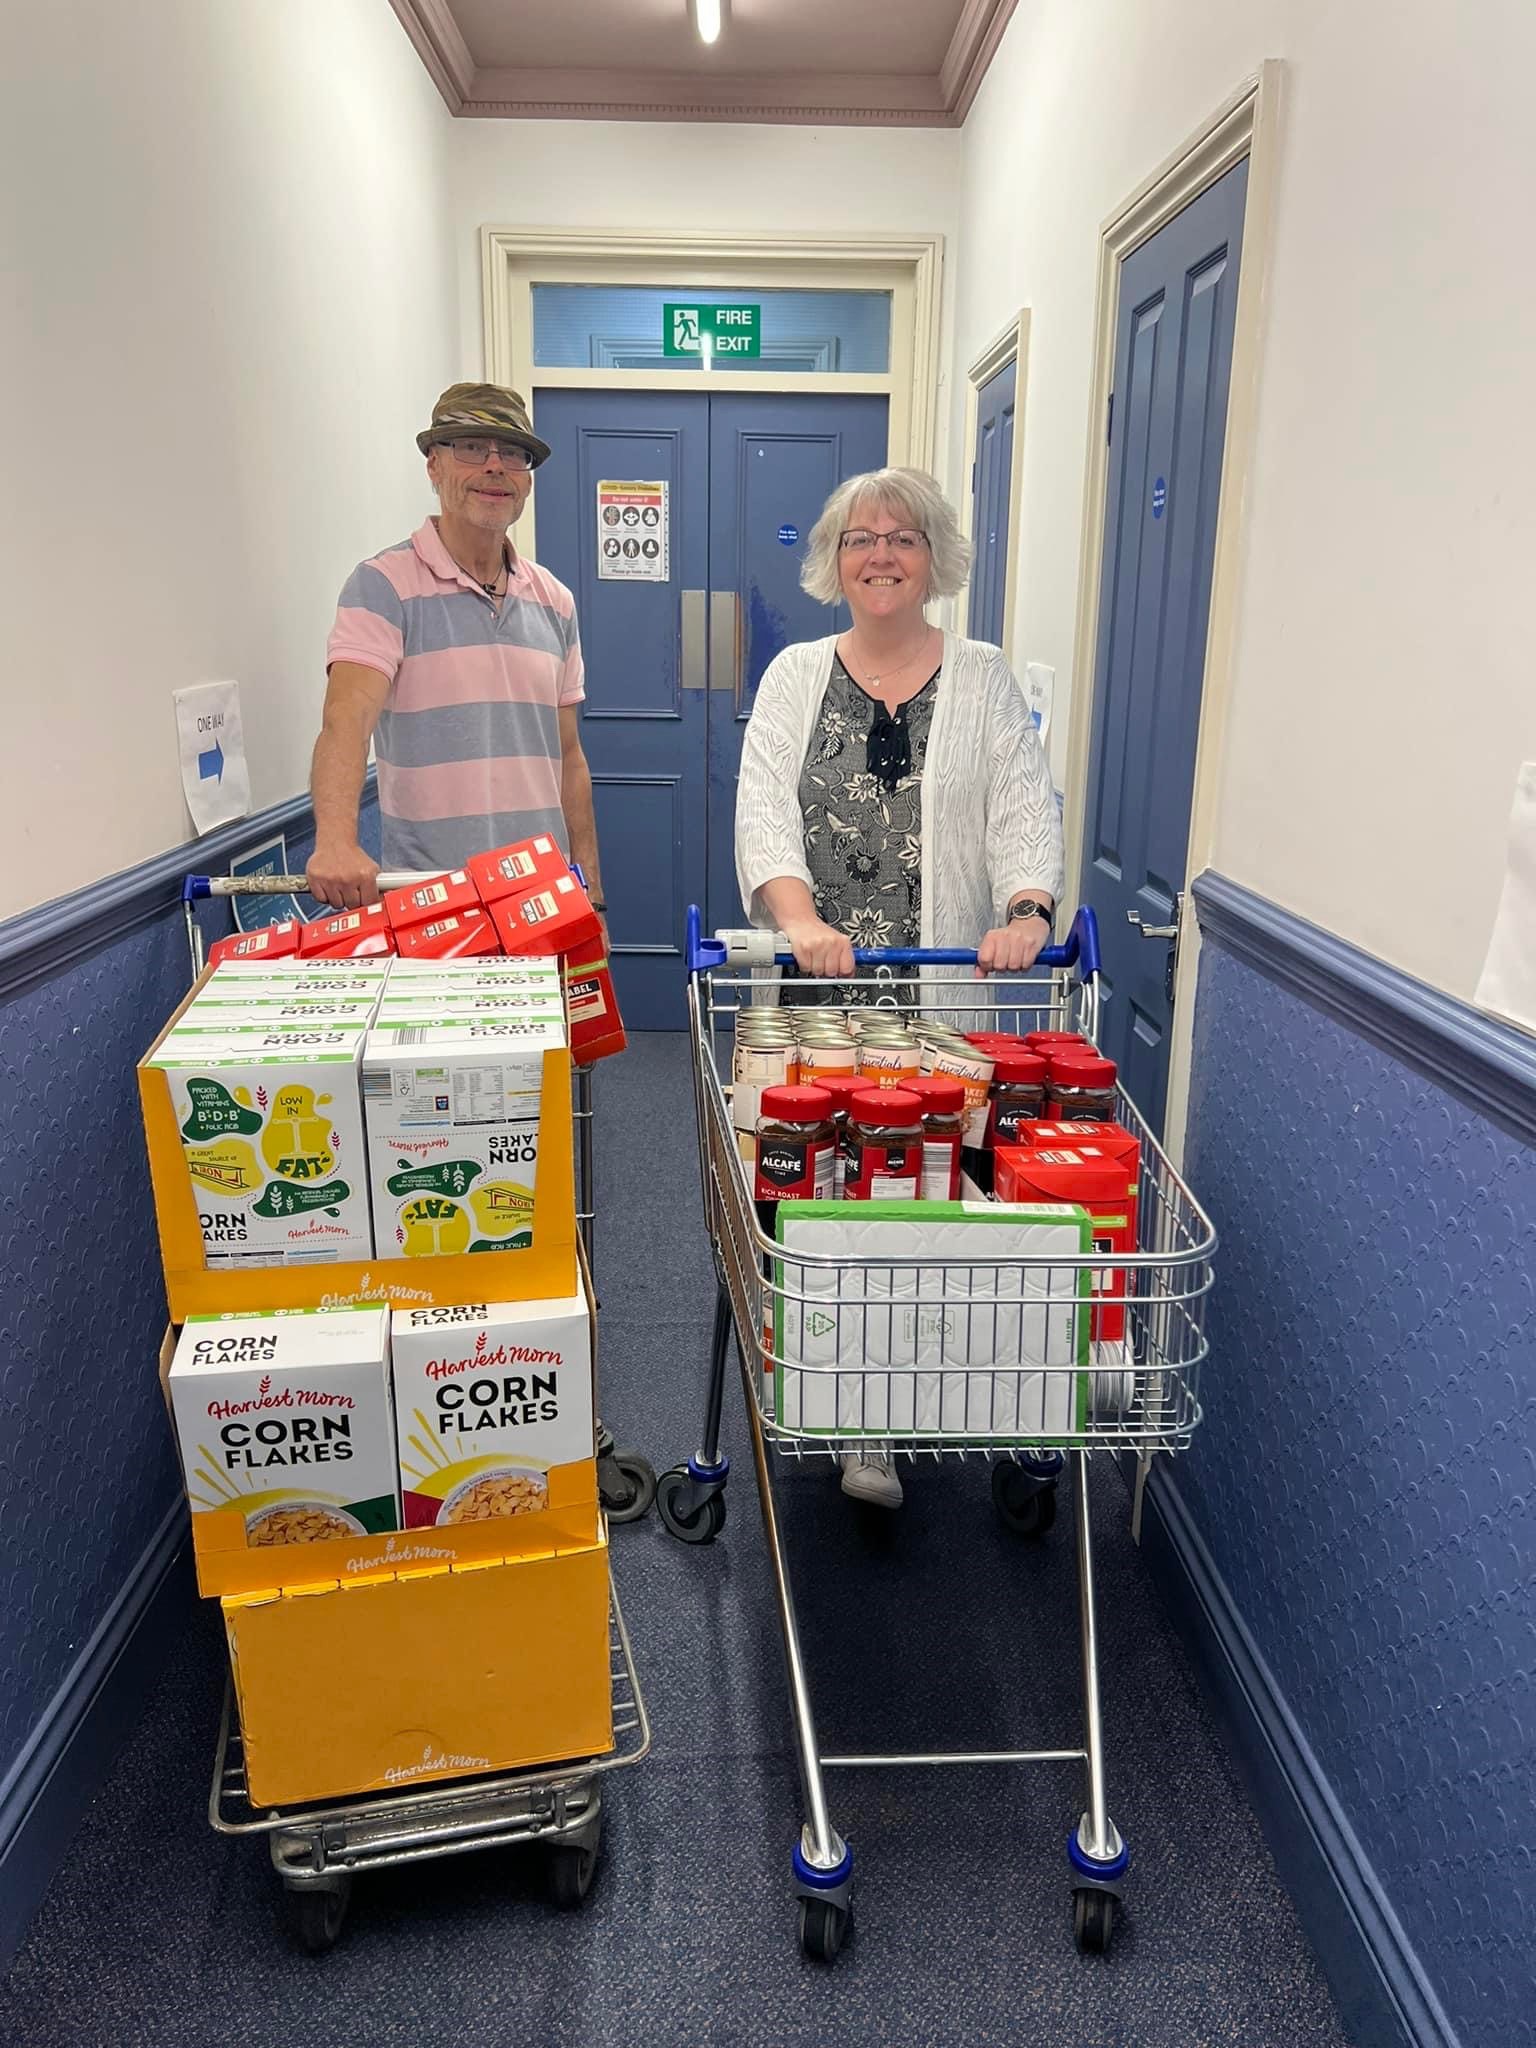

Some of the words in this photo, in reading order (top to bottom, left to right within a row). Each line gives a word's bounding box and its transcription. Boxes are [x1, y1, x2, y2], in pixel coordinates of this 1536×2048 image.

[716, 310, 752, 325] FIRE
[716, 336, 752, 351] EXIT
[197, 716, 211, 732] ONE
[211, 712, 224, 729] WAY
[295, 982, 367, 990] CORN
[569, 983, 592, 996] ABEL
[280, 1007, 357, 1015] CORN
[470, 1023, 546, 1032] CORN
[471, 1028, 546, 1036] FLAKES
[262, 1035, 344, 1045] CORN
[280, 1096, 303, 1106] LOW
[287, 1107, 298, 1115] IN
[414, 1138, 449, 1154] Harvest
[489, 1134, 535, 1148] AKES
[489, 1147, 537, 1164] ORN
[275, 1157, 325, 1179] FAT
[761, 1156, 801, 1172] ALCAFÉ
[761, 1188, 776, 1197] RICH
[778, 1191, 800, 1200] ROAST
[413, 1199, 459, 1220] FAT
[200, 1213, 246, 1228] ORN
[204, 1228, 248, 1241] AKES
[288, 1225, 324, 1239] Harvest
[324, 1225, 350, 1236] Morn
[321, 1283, 387, 1307] Harvest
[388, 1285, 435, 1303] Morn
[410, 1304, 488, 1319] CORN
[411, 1312, 489, 1327] FLAKES
[195, 1335, 278, 1353] CORN
[192, 1349, 275, 1366] FLAKES
[425, 1345, 507, 1381] Harvest
[508, 1346, 564, 1366] Morn
[435, 1371, 557, 1410] CORN
[207, 1388, 294, 1420] Harvest
[295, 1390, 356, 1409] Morn
[439, 1400, 559, 1434] FLAKES
[220, 1414, 351, 1448] CORN
[225, 1441, 353, 1469] FLAKES
[346, 1546, 412, 1573] Harvest
[413, 1546, 458, 1560] Morn
[384, 1753, 447, 1783] Harvest
[448, 1754, 492, 1768] Morn
